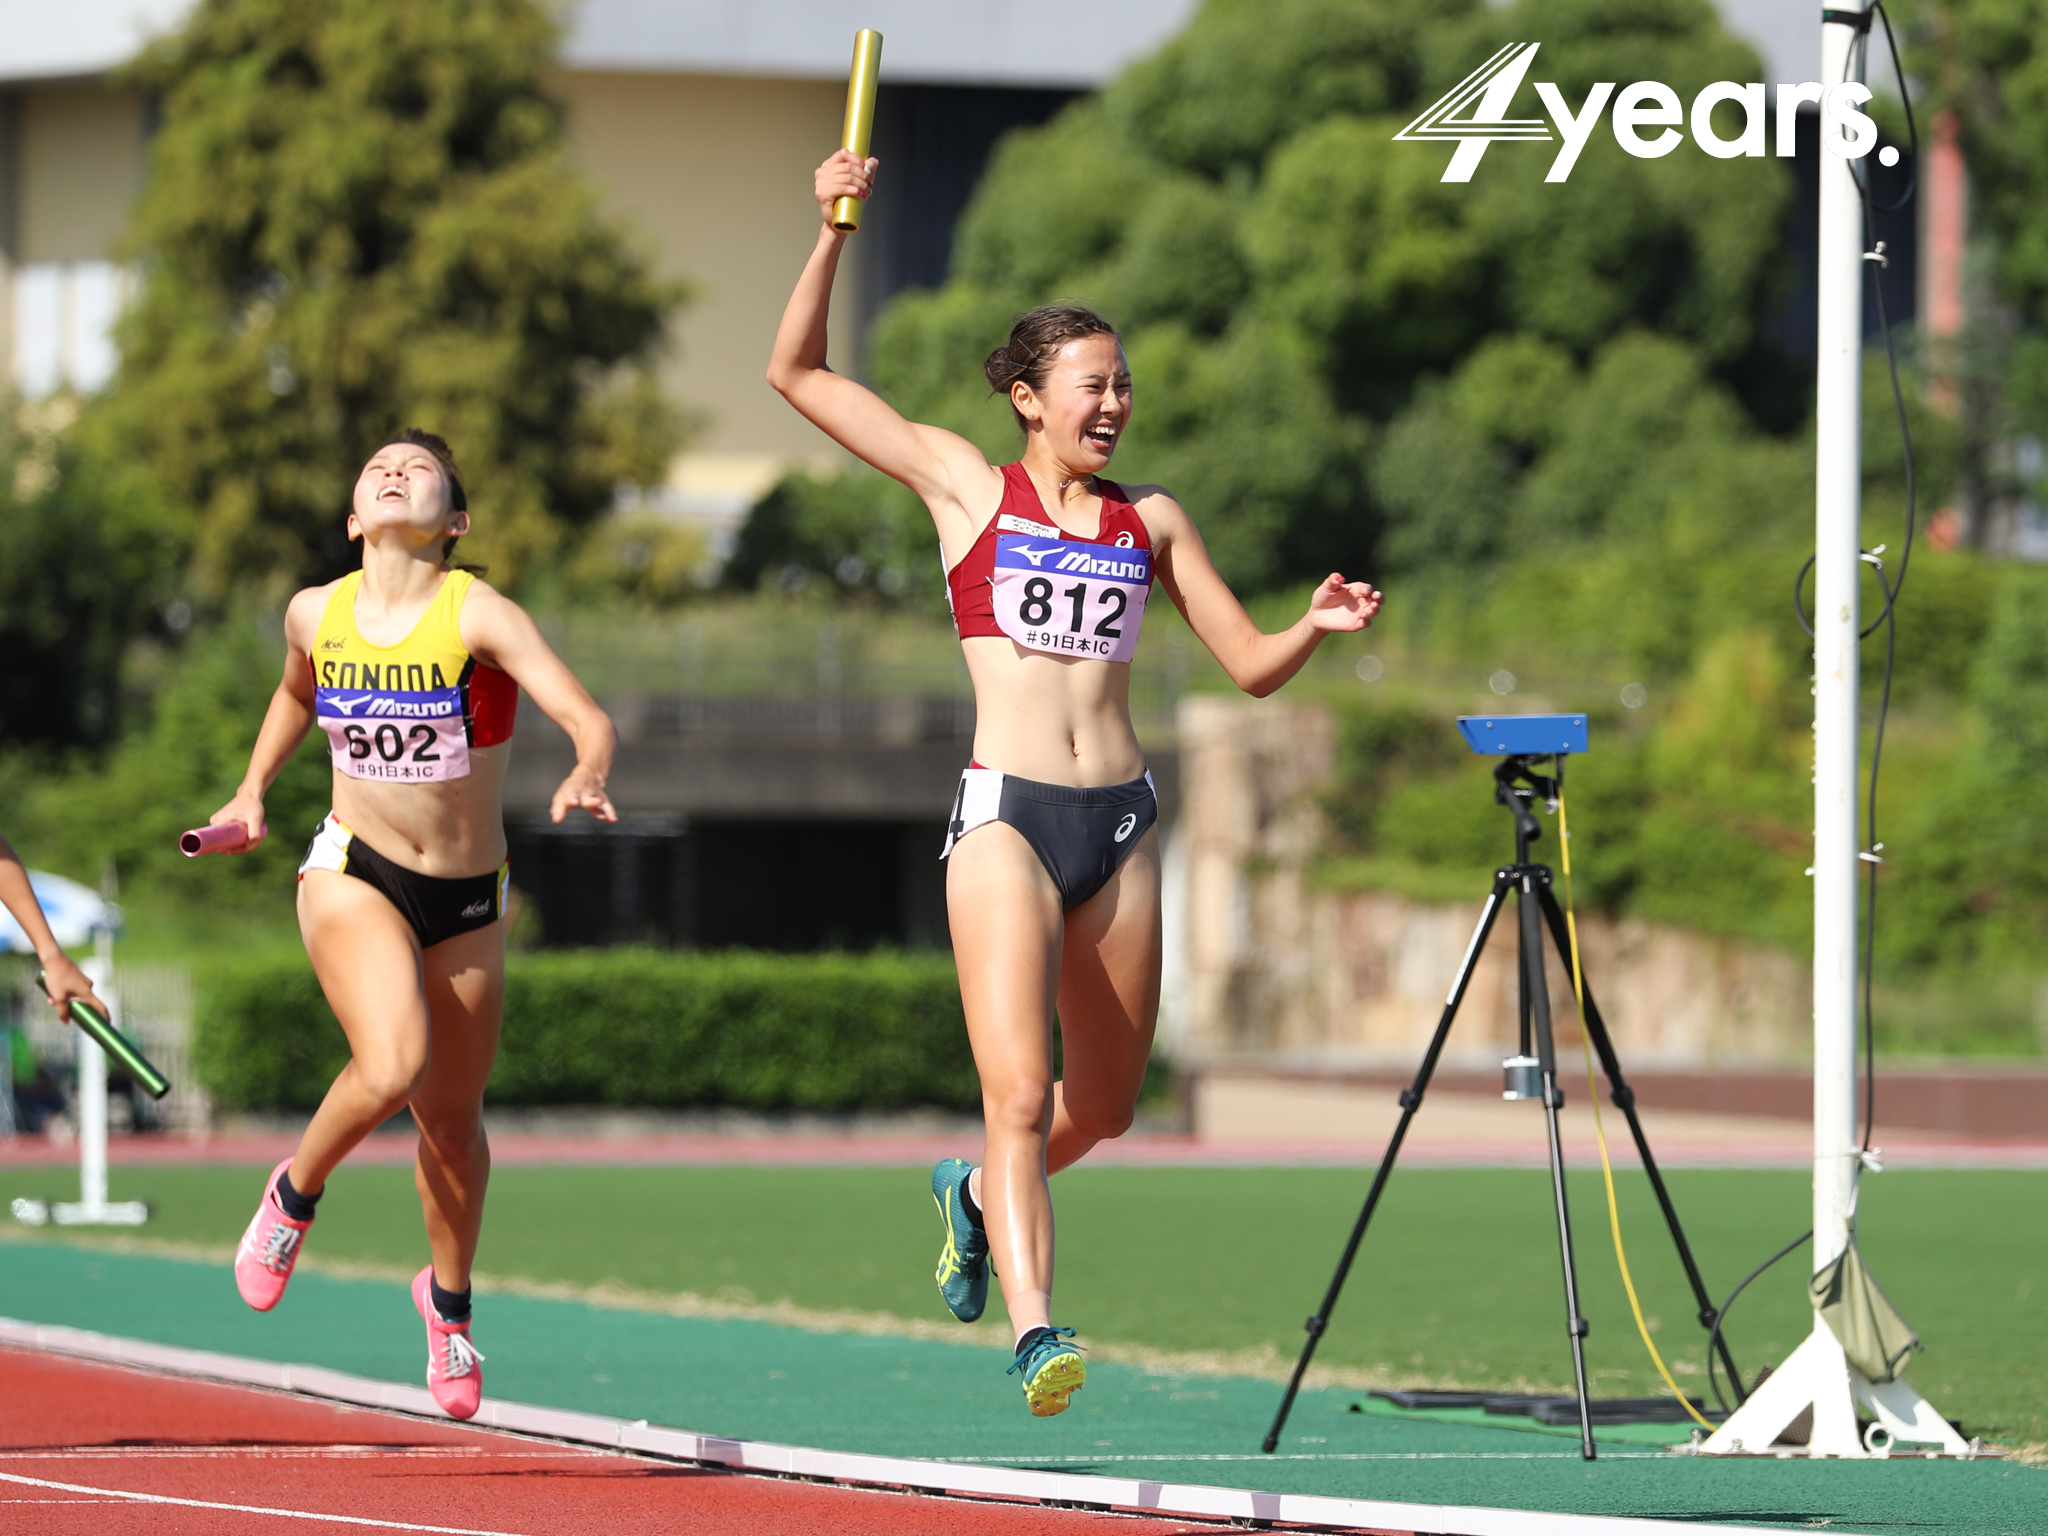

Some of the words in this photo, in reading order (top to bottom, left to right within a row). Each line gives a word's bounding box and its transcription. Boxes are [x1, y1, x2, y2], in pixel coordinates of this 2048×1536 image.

[1019, 577, 1128, 639] 812
[321, 661, 447, 692] SONODA
[343, 723, 441, 762] 602
